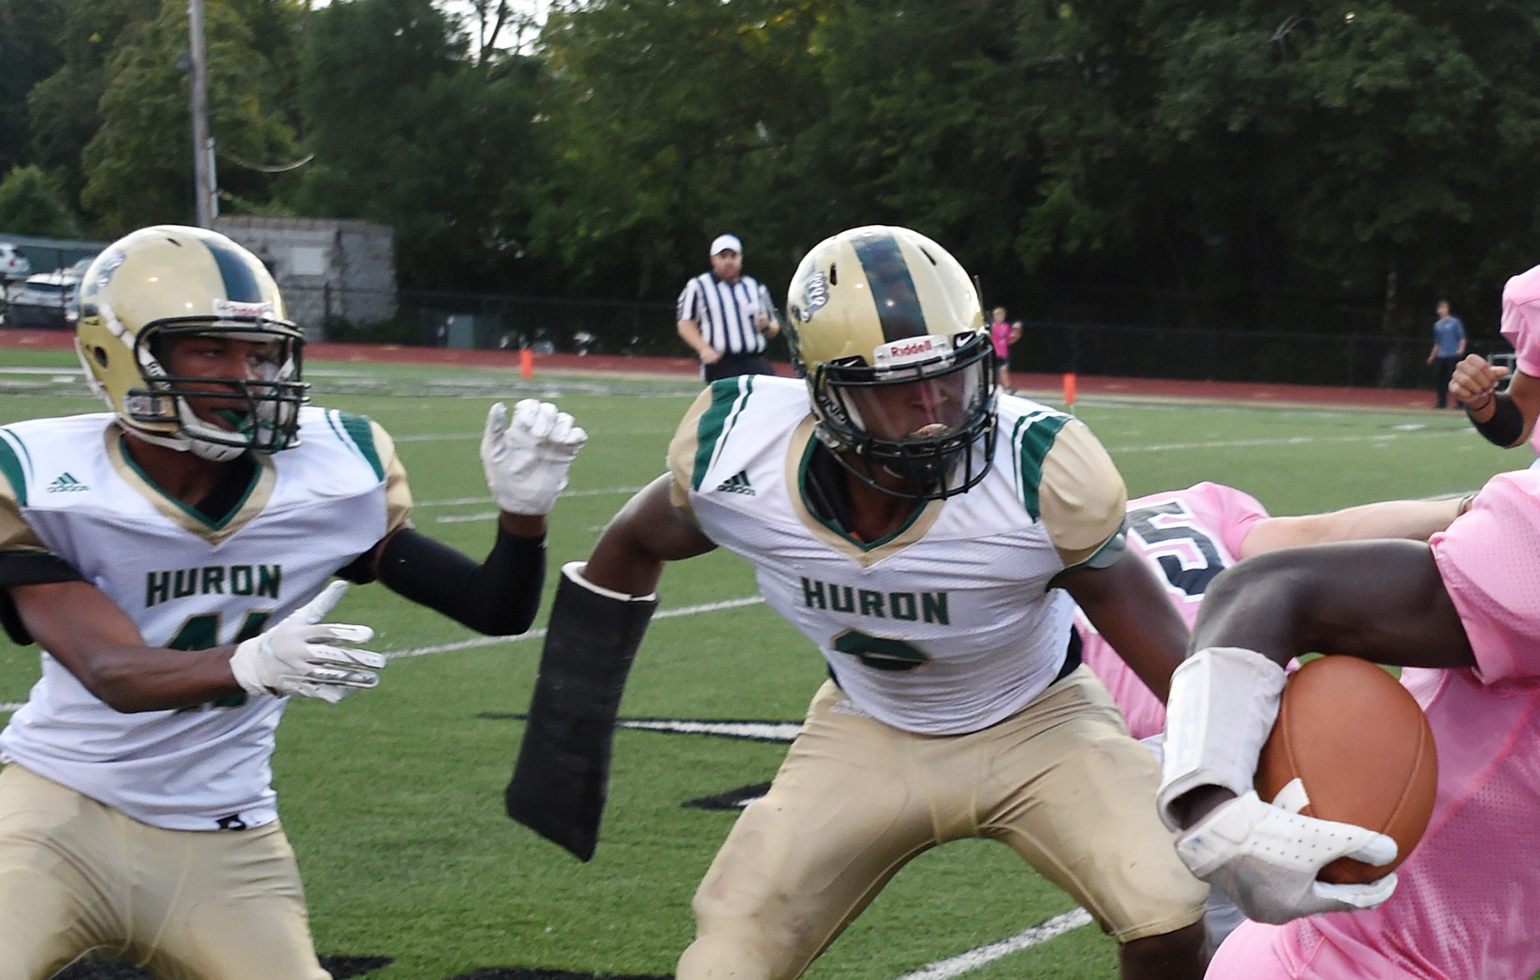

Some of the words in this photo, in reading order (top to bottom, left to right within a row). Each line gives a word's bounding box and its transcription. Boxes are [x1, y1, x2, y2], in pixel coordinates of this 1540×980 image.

[890, 341, 932, 357] Riddell
[145, 564, 281, 608] HURON
[801, 576, 949, 625] HURON
